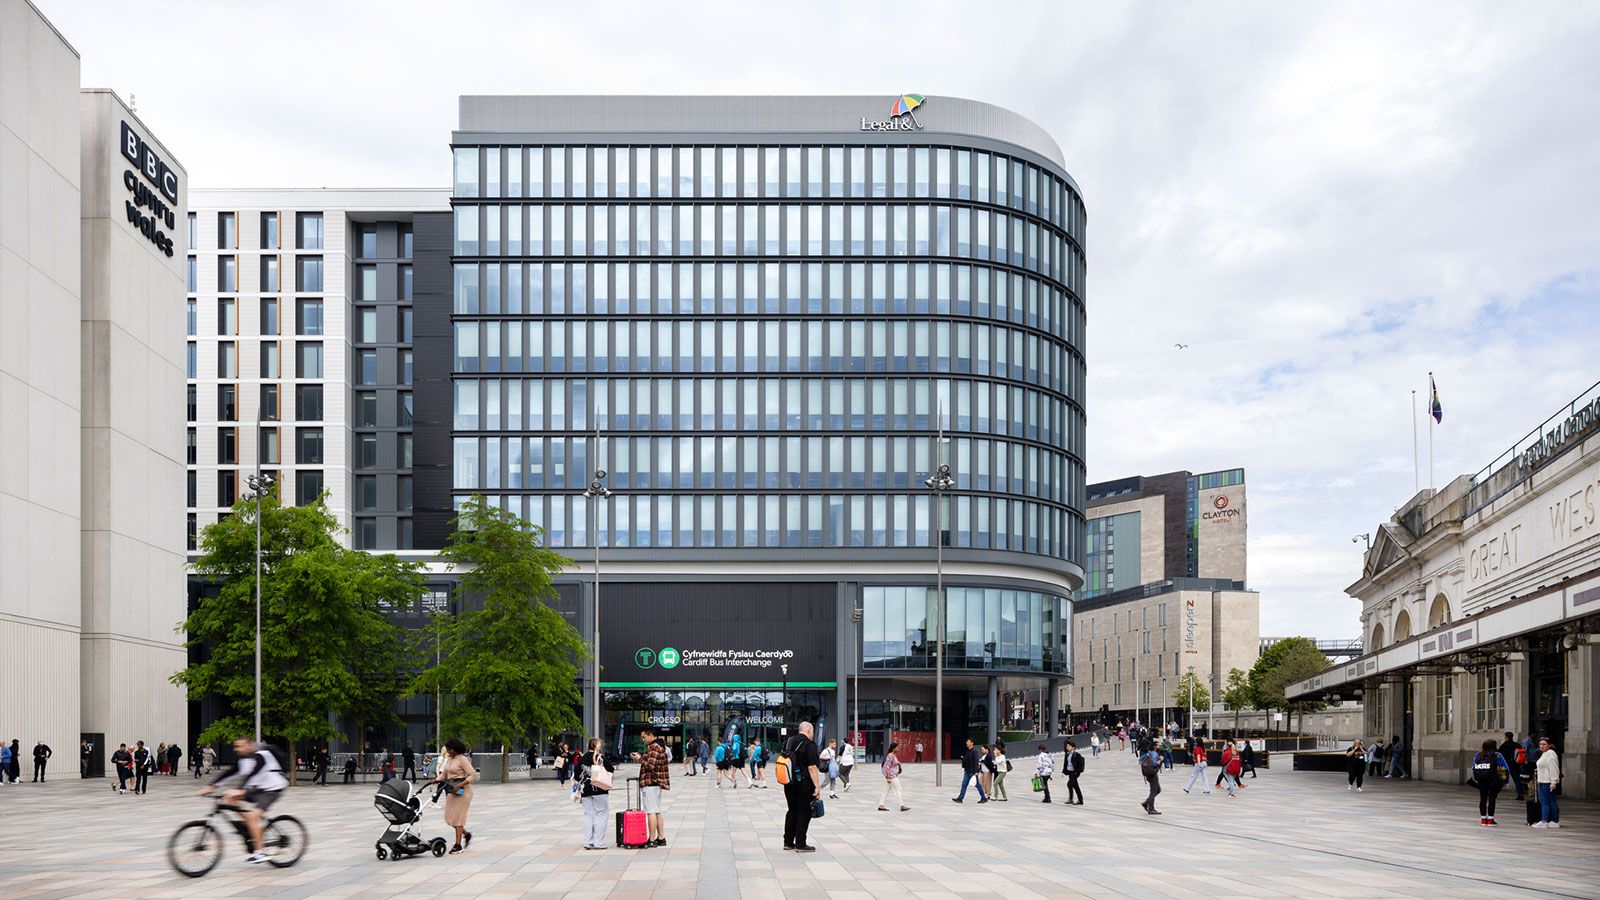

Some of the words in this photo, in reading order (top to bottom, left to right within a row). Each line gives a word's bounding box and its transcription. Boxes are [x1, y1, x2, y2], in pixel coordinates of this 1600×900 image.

[861, 117, 899, 131] Legal
[900, 117, 913, 130] &
[121, 120, 177, 206] BBC
[125, 199, 174, 258] wales
[1202, 509, 1240, 520] CLAYTON
[1549, 480, 1600, 545] WES
[682, 649, 727, 660] Cyfnewidfa
[728, 649, 754, 660] Fysiau
[682, 658, 708, 666] Cardiff
[725, 658, 772, 668] Interchange
[648, 716, 681, 724] CROESO
[745, 716, 784, 724] WELCOME
